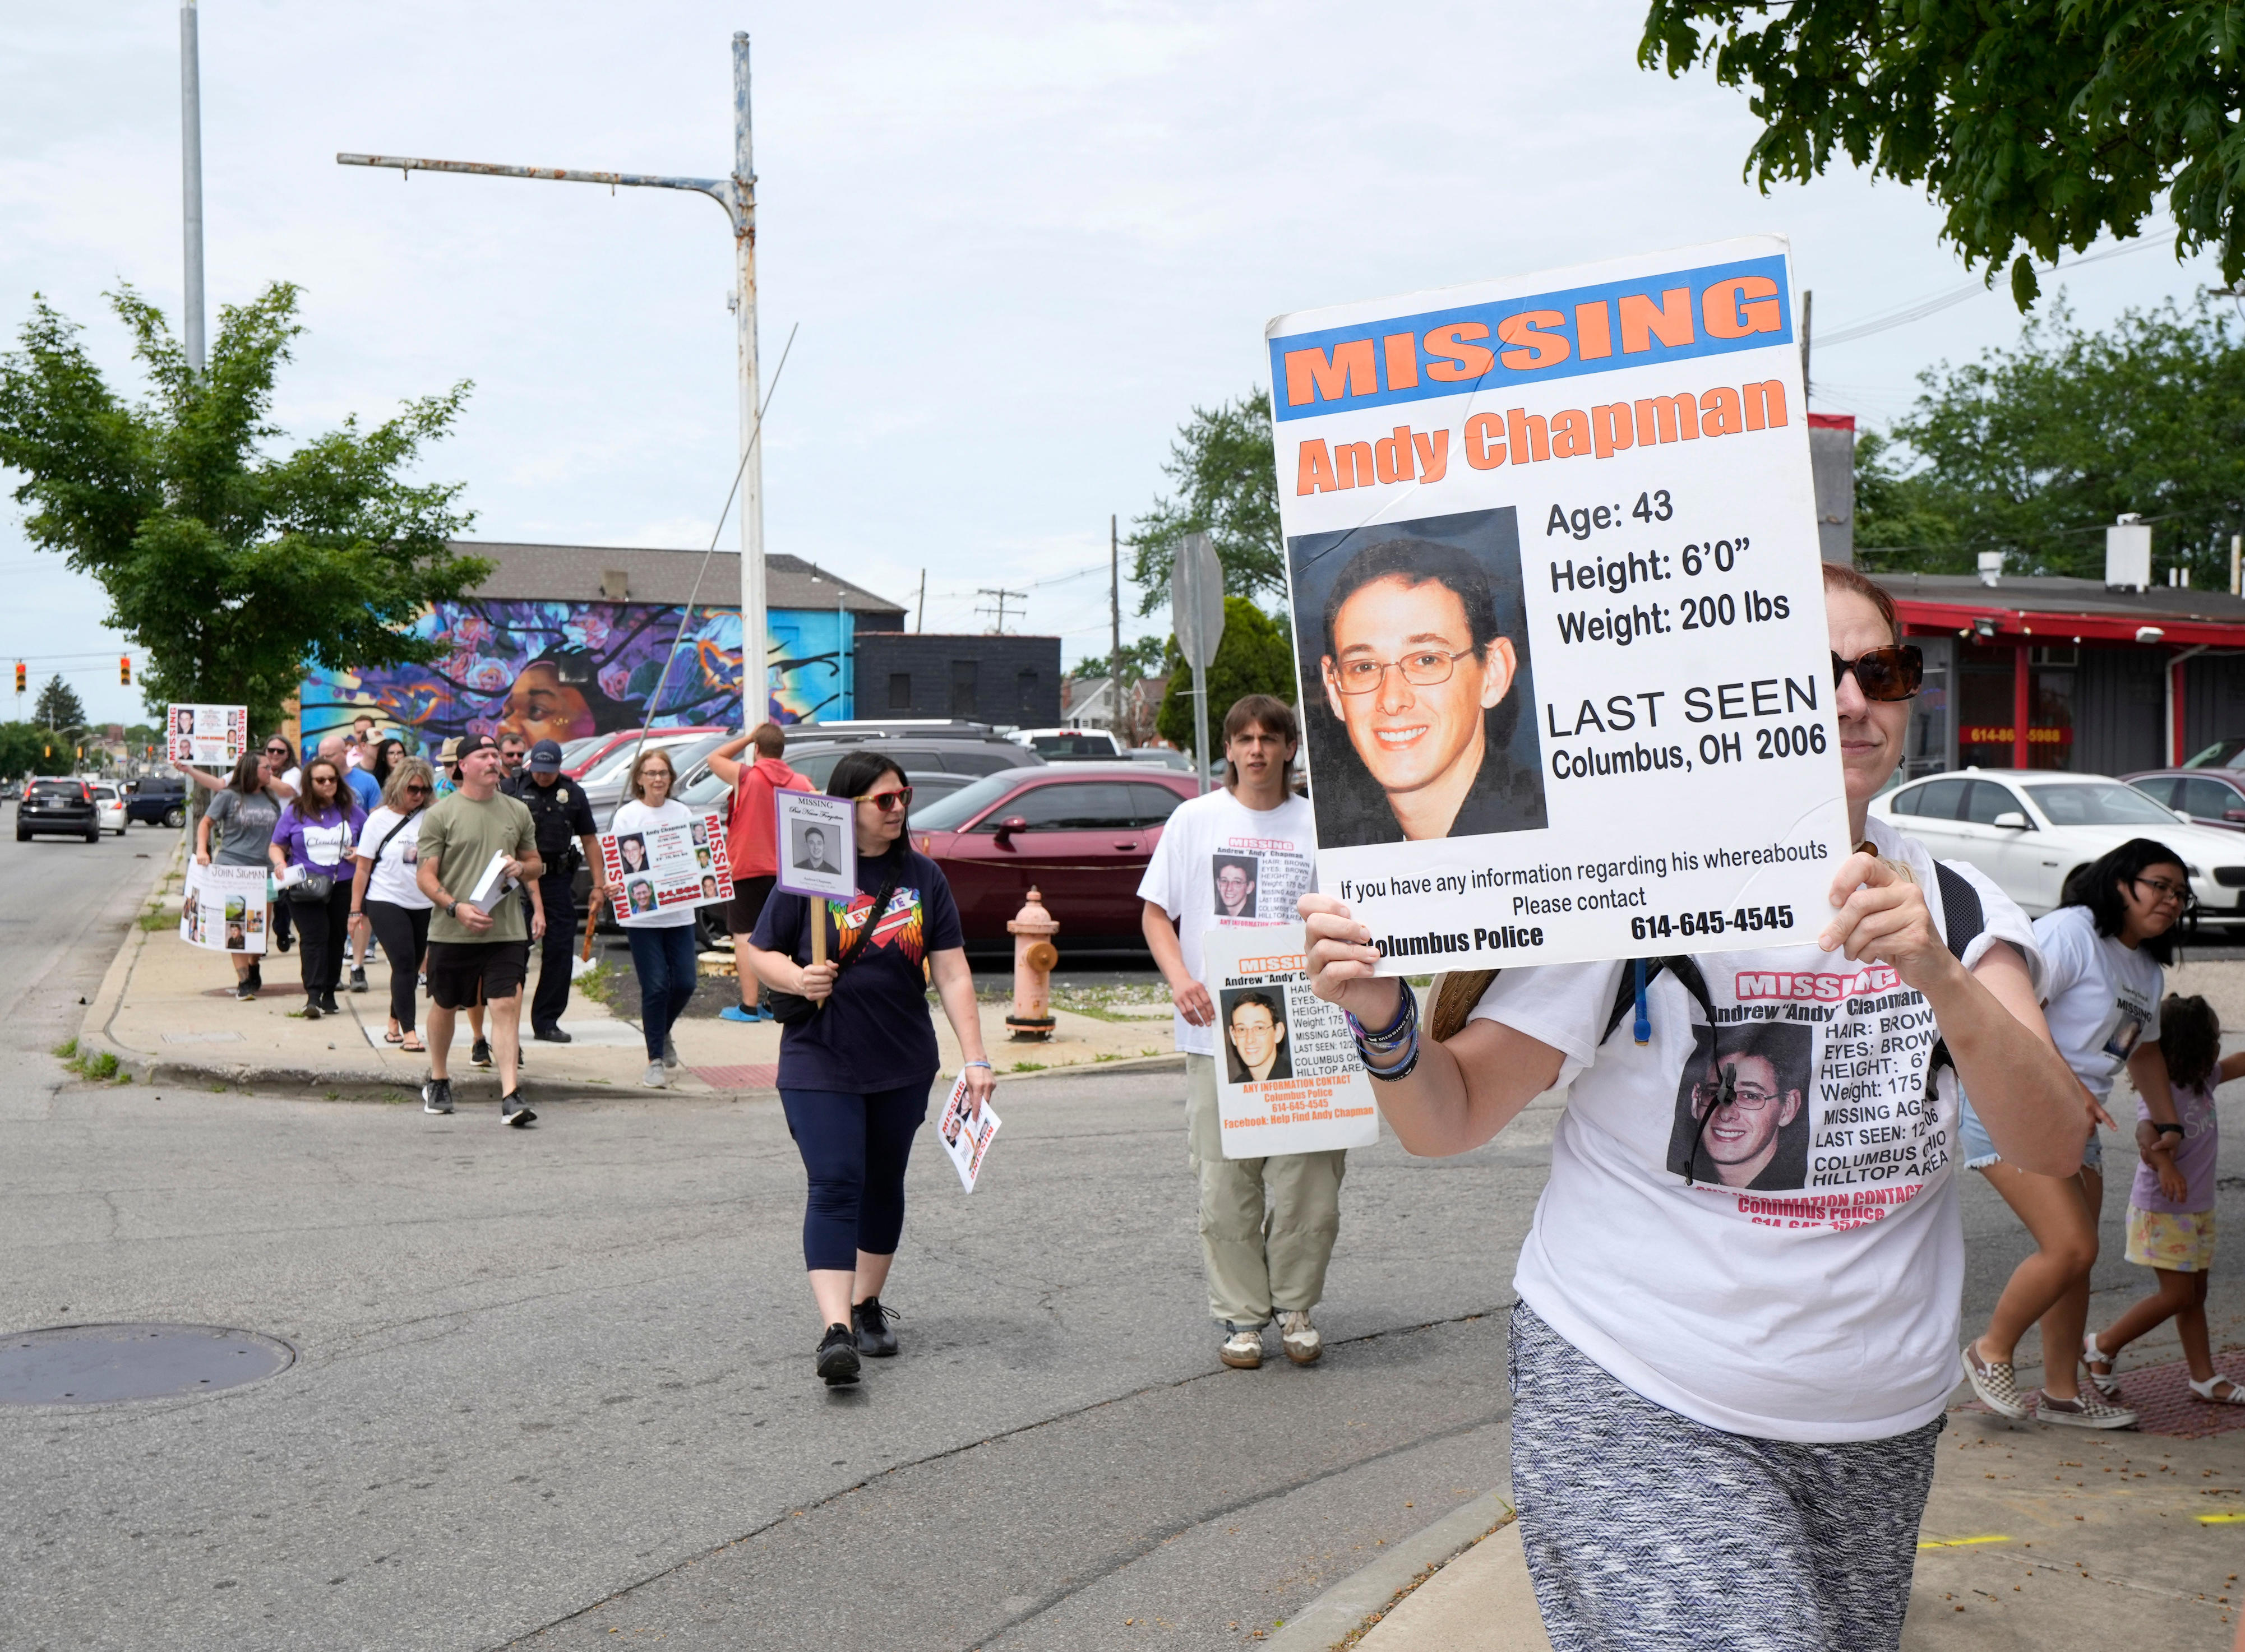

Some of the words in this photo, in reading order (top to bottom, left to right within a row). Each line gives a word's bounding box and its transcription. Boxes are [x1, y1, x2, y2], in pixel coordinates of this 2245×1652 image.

[1283, 275, 1781, 407] MISSING
[1296, 425, 1449, 497] Andy
[1464, 379, 1788, 471] Chapman
[1546, 503, 1622, 540] Age:
[1632, 489, 1673, 524] 43
[1550, 549, 1671, 594] Height:
[1557, 603, 1671, 646] Weight:
[1682, 593, 1736, 631] 200
[1744, 590, 1790, 623] lbs
[1547, 691, 1665, 738] LAST
[1684, 674, 1818, 723] SEEN
[1971, 728, 2061, 743] 614-86-5988
[1552, 741, 1693, 780] Columbus,
[1699, 731, 1742, 766] OH
[1756, 723, 1827, 760] 2006
[798, 797, 834, 809] MISSING
[1229, 837, 1294, 851] MISSING
[1270, 850, 1304, 859] Chapman
[704, 814, 733, 899] MISSING
[1284, 860, 1310, 868] BROWN
[211, 867, 234, 878] JOHN
[235, 867, 266, 880] SIGMAN
[1341, 880, 1351, 900] If
[1355, 882, 1386, 903] you
[1391, 876, 1432, 895] have
[1436, 875, 1467, 895] any
[1471, 863, 1572, 889] information
[1577, 855, 1667, 883] regarding
[1671, 850, 1699, 872] his
[1703, 840, 1828, 869] whereabouts
[1512, 895, 1572, 916] Please
[1577, 887, 1647, 911] contact
[1473, 926, 1544, 950] Police
[1630, 904, 1794, 940] 614-645-4545
[1239, 954, 1309, 974] MISSI
[1225, 977, 1263, 987] Andrew
[1736, 965, 1901, 1002] MISSING
[1291, 996, 1318, 1006] EYES:
[1292, 1005, 1333, 1016] HEIGHT:
[2117, 998, 2152, 1024] MISSING
[1293, 1016, 1325, 1029] Weight:
[1328, 1015, 1344, 1026] 175
[1378, 1020, 1406, 1042] MISSING
[1825, 1022, 1873, 1039] HAIR:
[1296, 1030, 1329, 1041] MISSING
[1294, 1044, 1313, 1054] LAST
[1315, 1042, 1338, 1052] SEEN:
[1824, 1041, 1874, 1060] EYES:
[1295, 1054, 1345, 1066] COLUMBUS
[1821, 1058, 1898, 1080] HEIGHT:
[1296, 1066, 1338, 1077] HILLTOP
[1243, 1084, 1259, 1094] ANY
[1260, 1079, 1315, 1093] INFORMATION
[1316, 1075, 1351, 1086] CONTACT
[1264, 1091, 1306, 1103] Columbus
[1308, 1088, 1333, 1099] Police
[1820, 1080, 1882, 1103] Weight:
[1888, 1072, 1922, 1094] 175
[942, 1080, 966, 1134] MISSING
[1272, 1098, 1329, 1113] 614-645-4545
[1824, 1105, 1891, 1126] MISSING
[1224, 1116, 1269, 1130] Facebook:
[1270, 1113, 1290, 1126] Help
[1292, 1110, 1310, 1122] Find
[1311, 1109, 1333, 1121] Andy
[1334, 1107, 1374, 1119] Chapman
[1816, 1131, 1854, 1148] LAST
[1859, 1125, 1906, 1145] SEEN:
[970, 1125, 994, 1180] MISSING
[1814, 1146, 1917, 1172] COLUMBUS
[1813, 1165, 1900, 1187] HILLTOP
[1904, 1150, 1949, 1176] AREA
[1853, 1184, 1924, 1206] CONTACT
[1738, 1197, 1826, 1220] Columbus
[1830, 1206, 1885, 1221] Police
